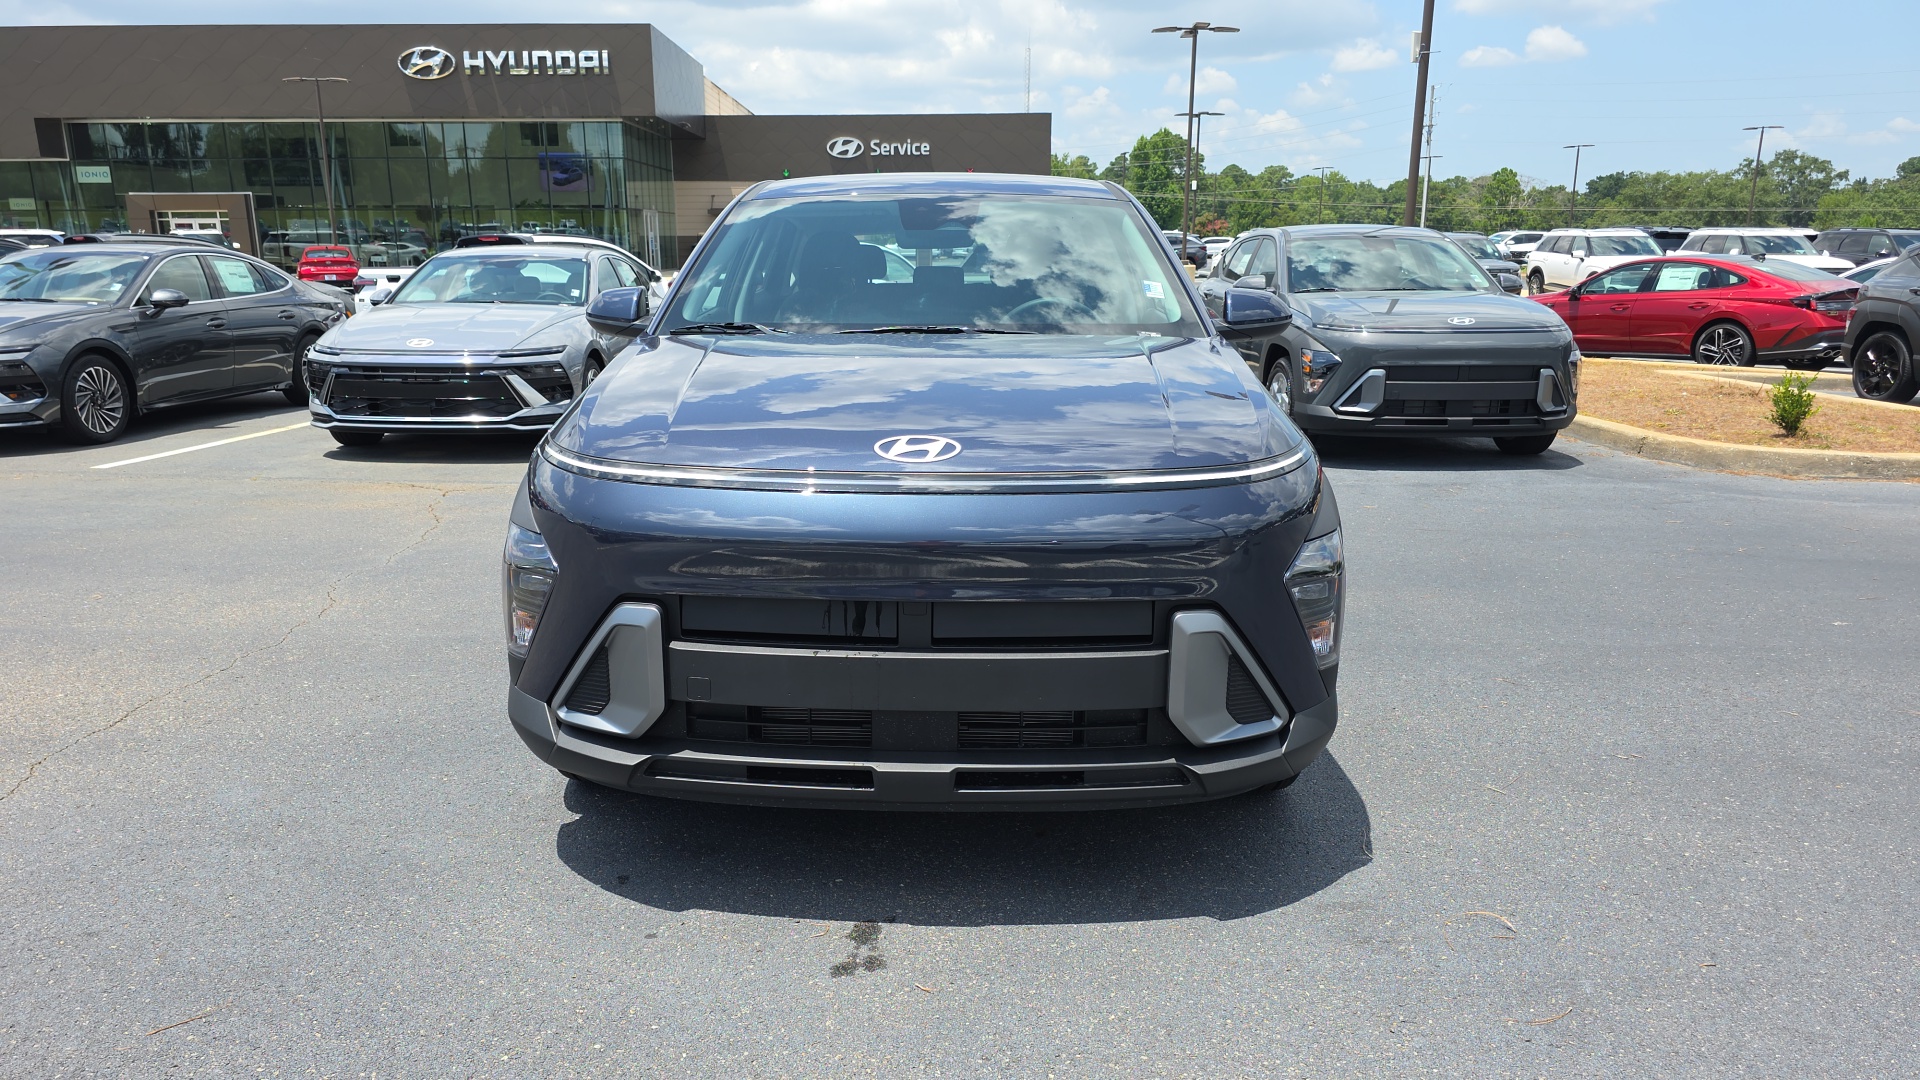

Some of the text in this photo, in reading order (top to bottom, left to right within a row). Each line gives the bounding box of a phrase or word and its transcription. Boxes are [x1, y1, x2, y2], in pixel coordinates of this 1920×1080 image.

[463, 50, 610, 76] HYUNDAI
[870, 138, 930, 156] Service
[80, 171, 109, 179] IONIQ
